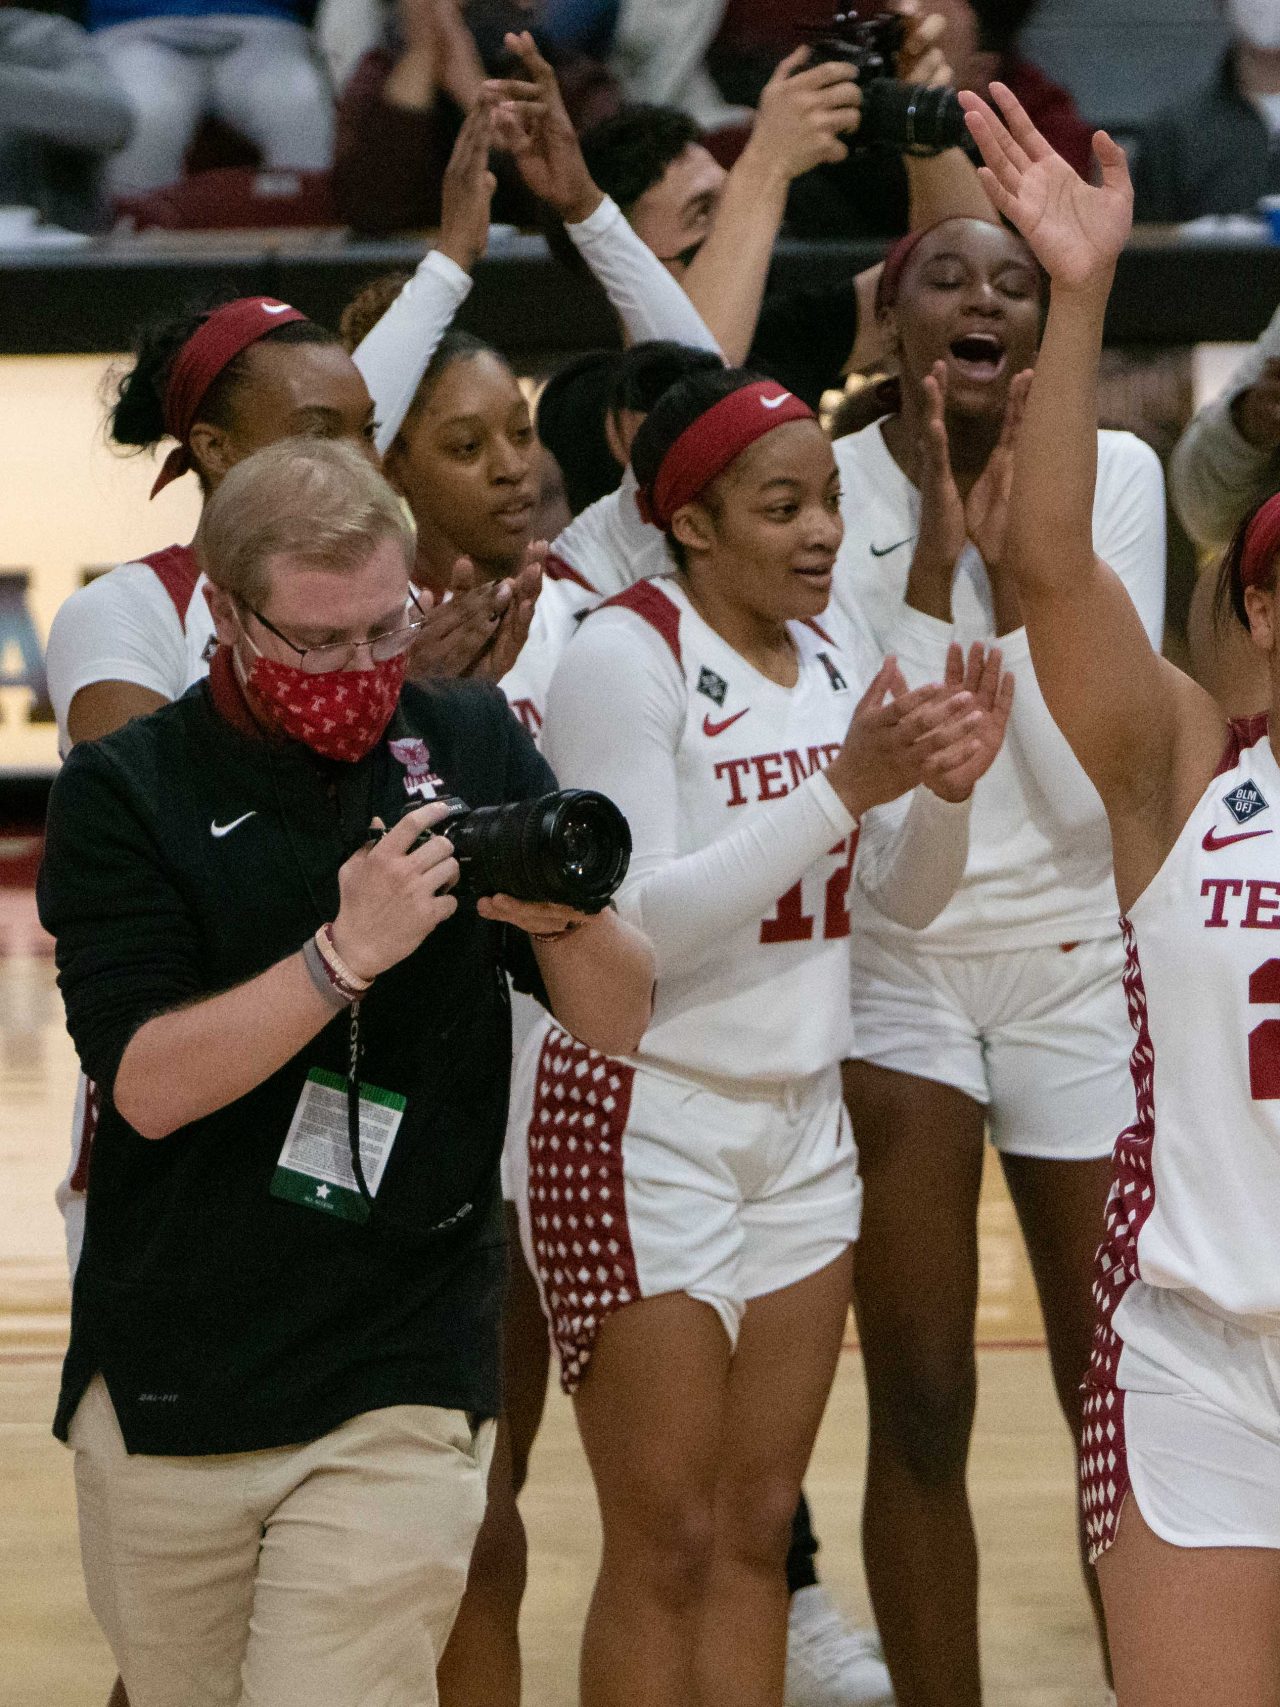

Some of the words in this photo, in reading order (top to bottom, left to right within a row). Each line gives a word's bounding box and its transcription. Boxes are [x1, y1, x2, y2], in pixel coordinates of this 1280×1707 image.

[714, 743, 843, 807] TEM
[1236, 789, 1257, 802] BLM
[1235, 801, 1252, 813] OFJ
